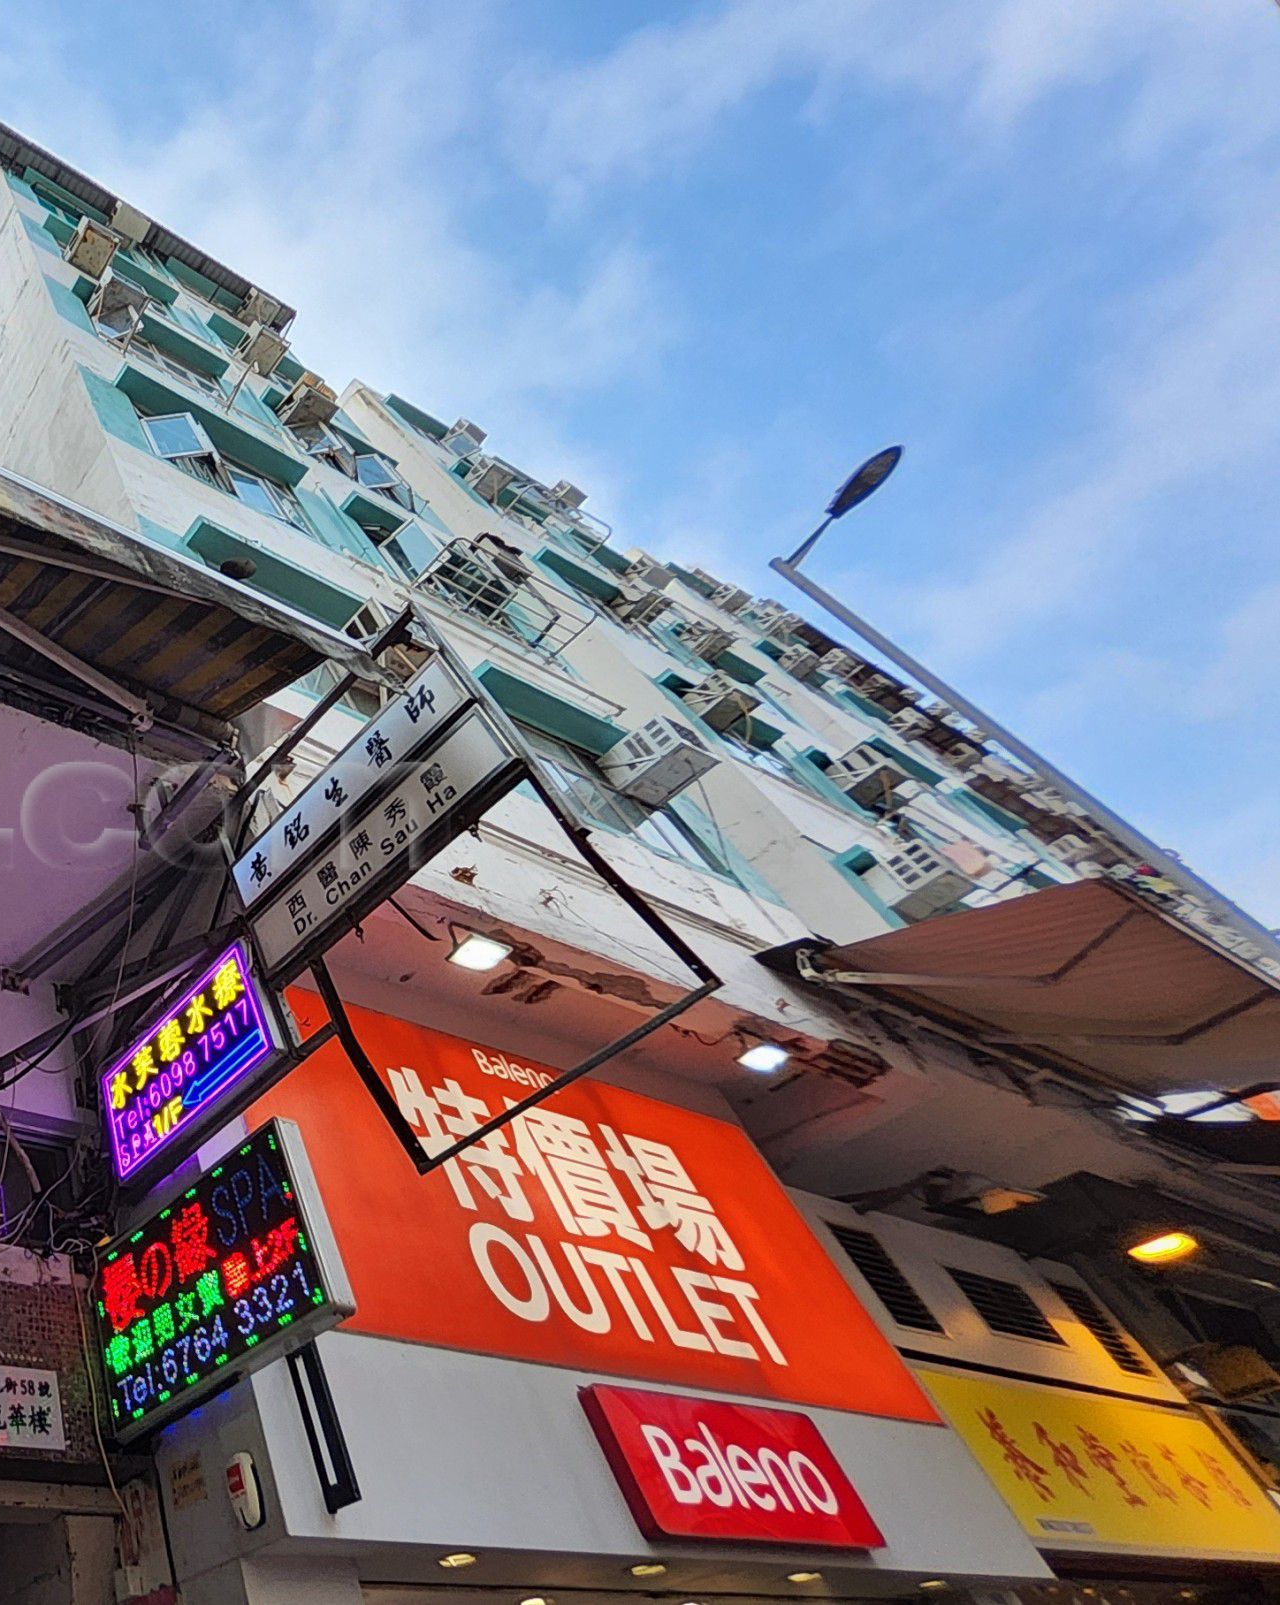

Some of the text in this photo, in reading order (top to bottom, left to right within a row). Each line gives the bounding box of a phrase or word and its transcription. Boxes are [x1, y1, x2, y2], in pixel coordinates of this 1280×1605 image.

[285, 762, 448, 919] 西醫陳秀霞
[292, 784, 458, 936] Dr. Chan Sau Ha
[196, 998, 250, 1063] 7517
[211, 1153, 288, 1248] SPA
[387, 1066, 746, 1272] 特價場
[232, 1260, 311, 1336] 3321
[468, 1222, 789, 1367] OUTLET
[640, 1421, 839, 1516] Baleno
